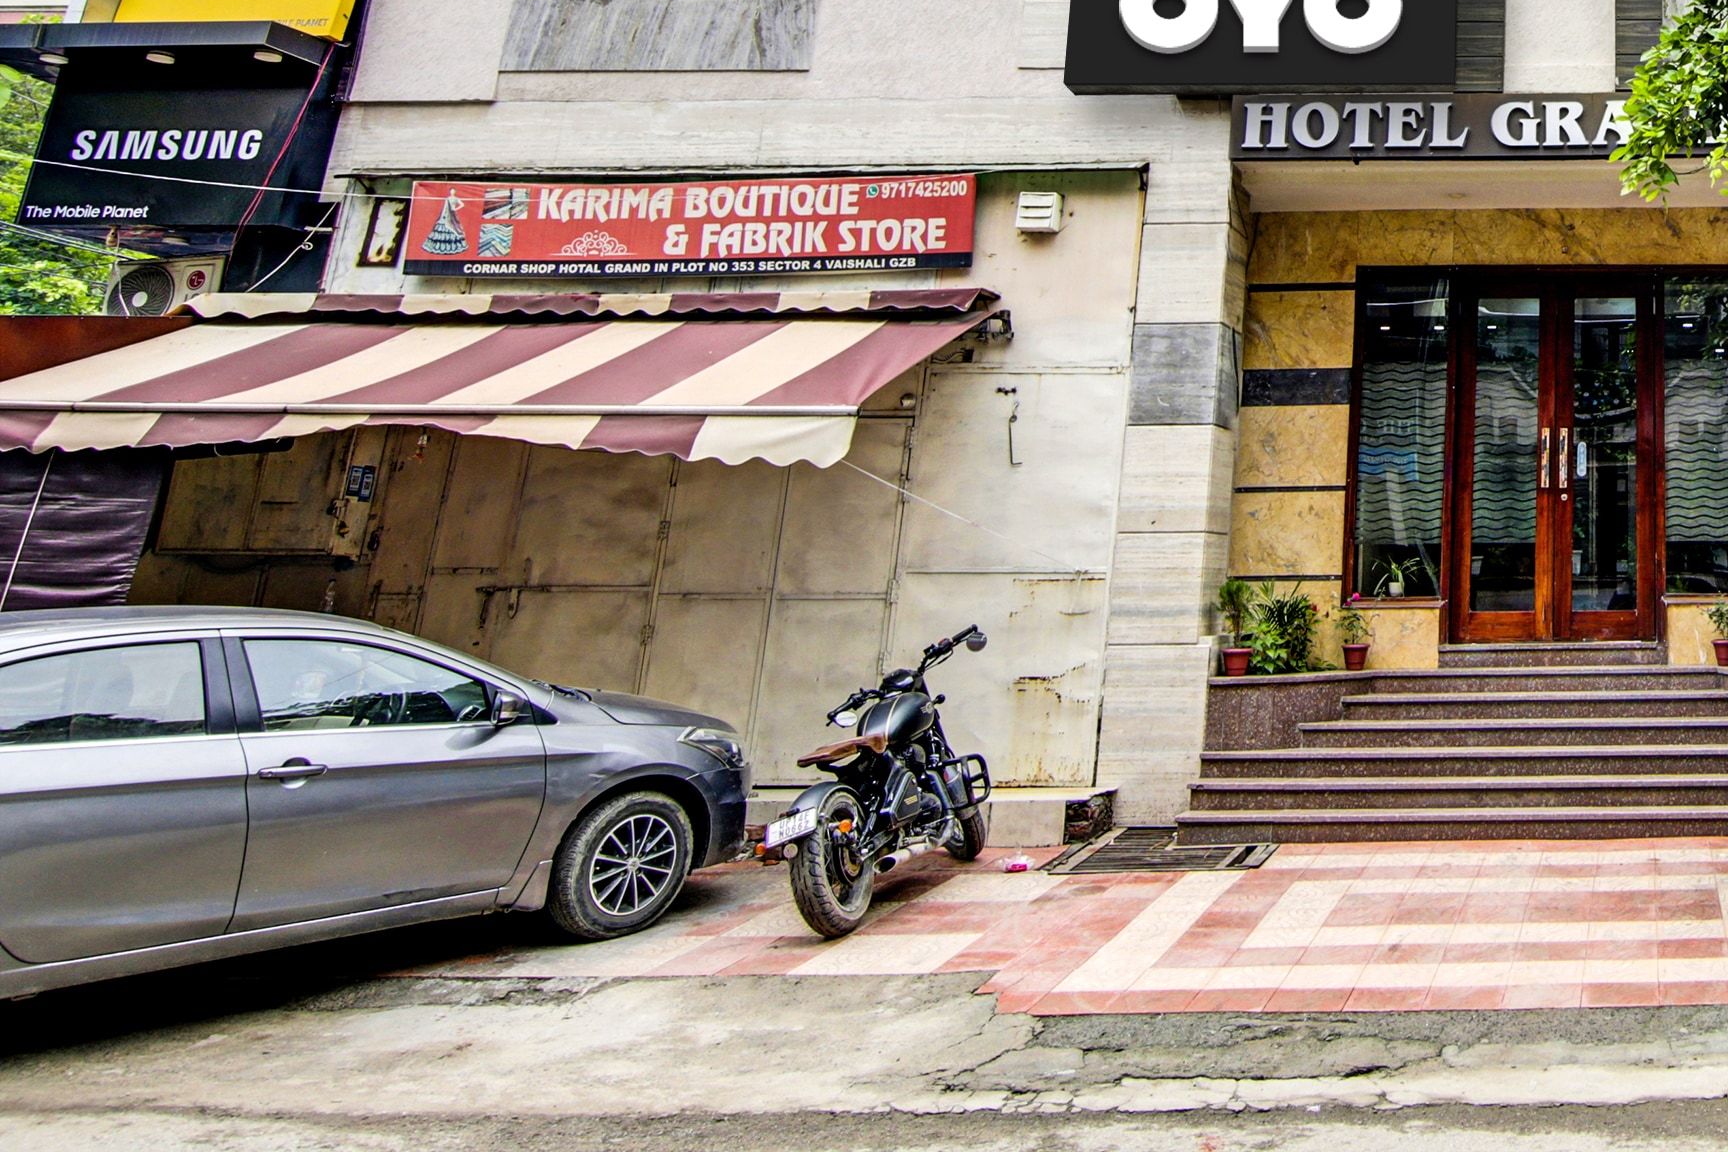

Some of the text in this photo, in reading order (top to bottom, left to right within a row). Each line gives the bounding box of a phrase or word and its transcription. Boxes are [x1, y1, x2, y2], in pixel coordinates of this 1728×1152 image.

[1241, 101, 1470, 149] HOTEL
[71, 129, 263, 161] SAMSUNG
[26, 204, 149, 218] The Mobile Planet
[537, 180, 968, 223] KARIMA BOUTIQUE 9717425200
[663, 218, 947, 259] & FABRIK STORE
[463, 258, 917, 274] CORNAR SHOP HOTAL GRAND IN PLOT NO 353 SECTOR 4 VAISHALI GZB
